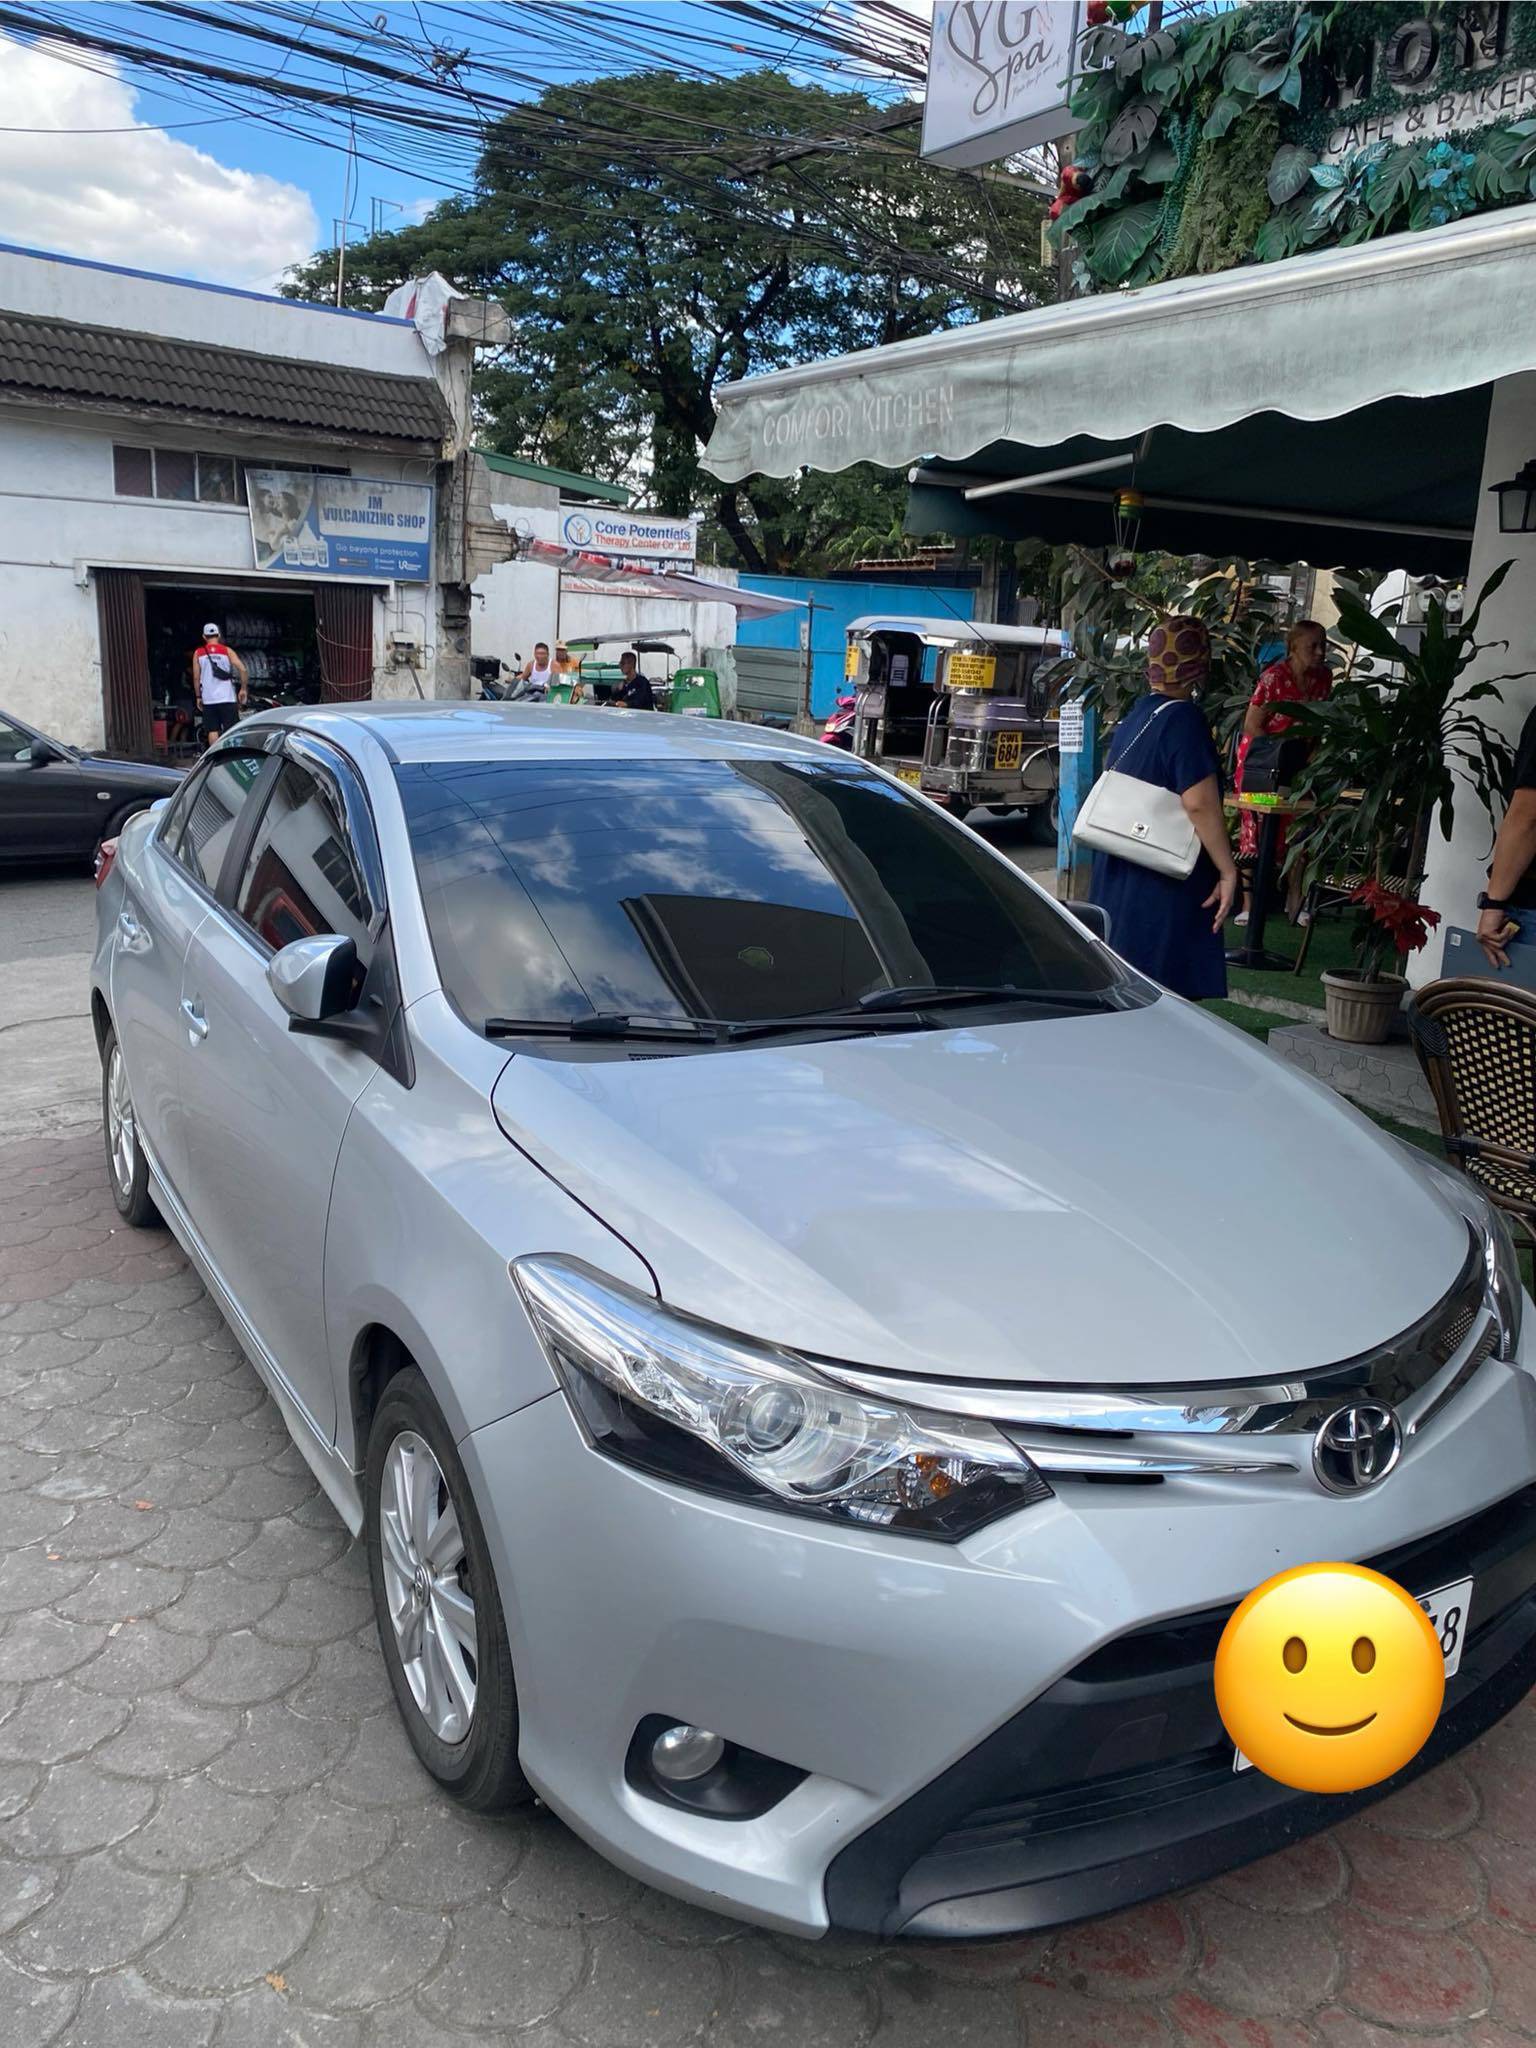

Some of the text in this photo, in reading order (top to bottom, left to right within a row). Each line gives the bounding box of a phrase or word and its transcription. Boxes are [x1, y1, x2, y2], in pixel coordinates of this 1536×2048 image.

[1327, 115, 1394, 155] CAFE
[1405, 104, 1425, 133] &
[862, 385, 953, 434] KITCHEN
[368, 496, 383, 509] JM
[322, 507, 426, 529] VULCANIZING SHOP
[595, 520, 692, 541] Core Potentials
[335, 543, 347, 552] Go
[349, 545, 379, 555] beyond
[595, 533, 629, 549] Therapy
[631, 538, 660, 549] Center
[998, 743, 1019, 763] 684
